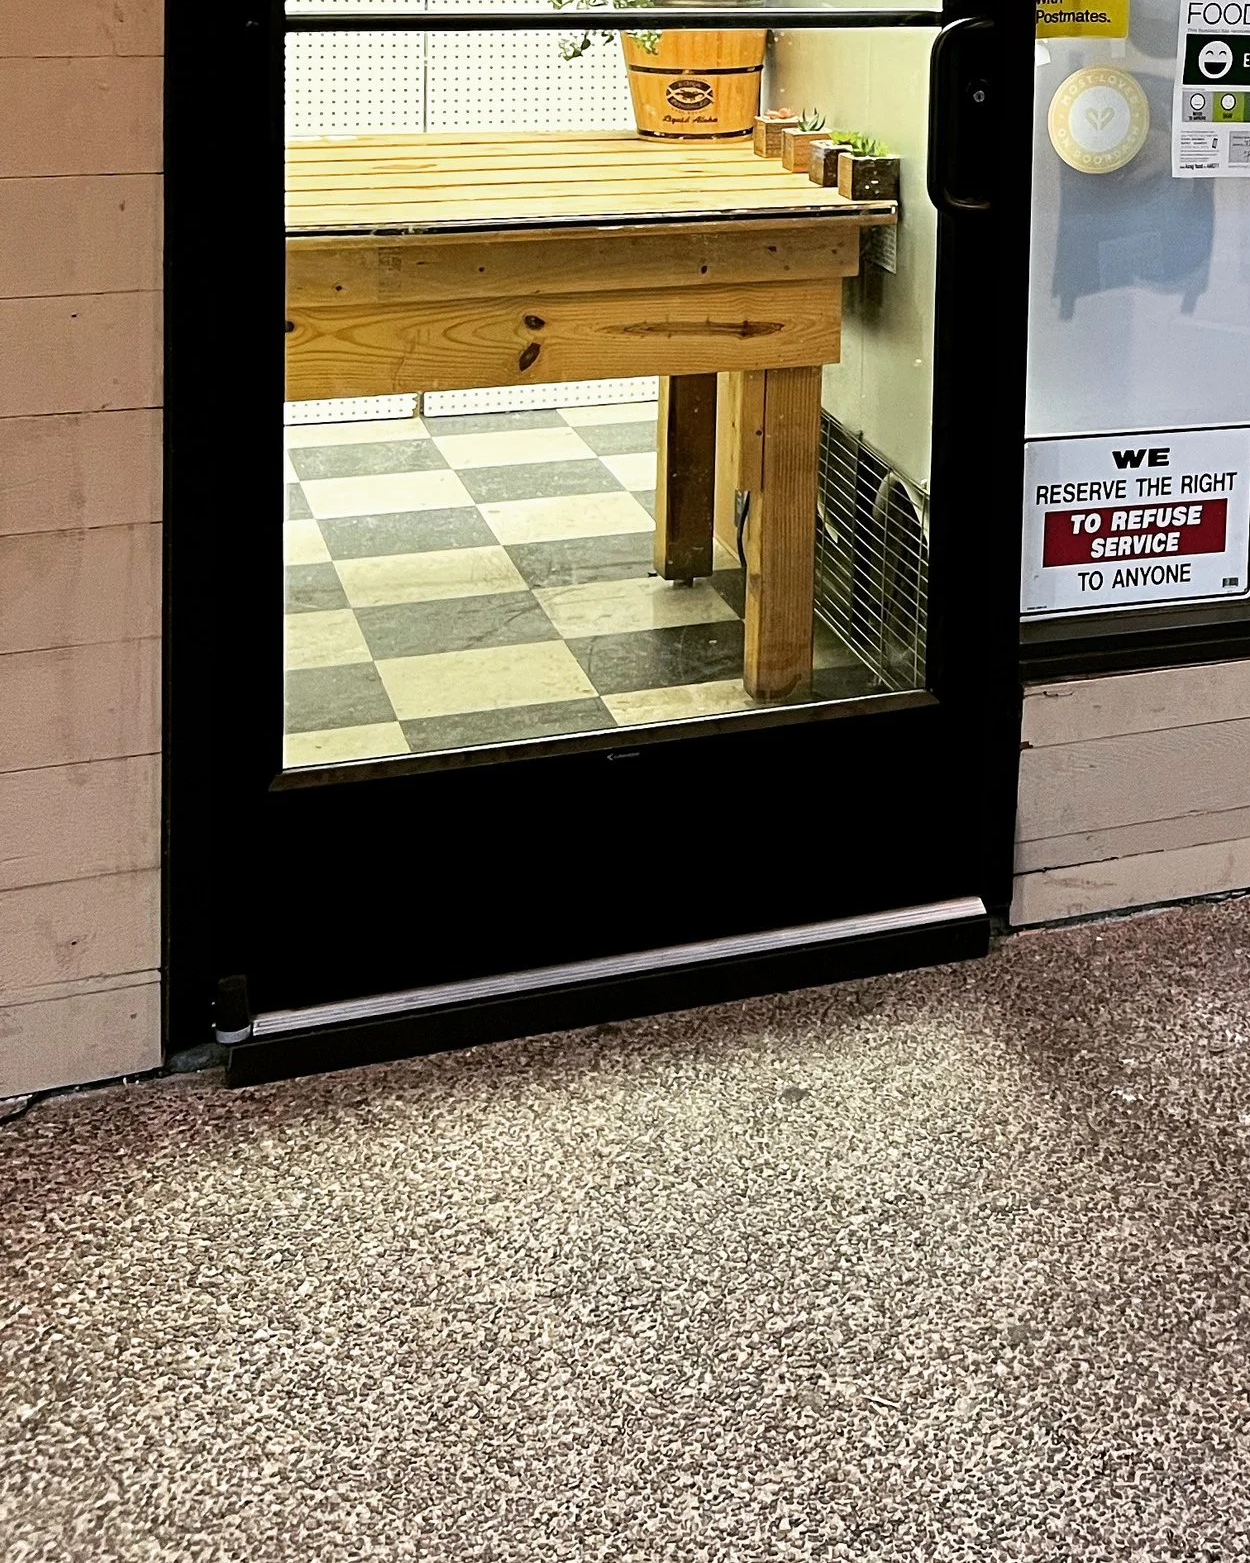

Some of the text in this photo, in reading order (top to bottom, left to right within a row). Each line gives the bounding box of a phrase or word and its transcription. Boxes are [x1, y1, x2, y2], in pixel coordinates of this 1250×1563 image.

[1035, 10, 1112, 24] Postmates.
[1112, 447, 1170, 469] WE
[1036, 472, 1238, 505] RESERVE THE RIGHT
[1071, 505, 1203, 534] TO REFUSE
[1090, 532, 1181, 559] SERVICE
[1077, 563, 1192, 592] TO ANYONE
